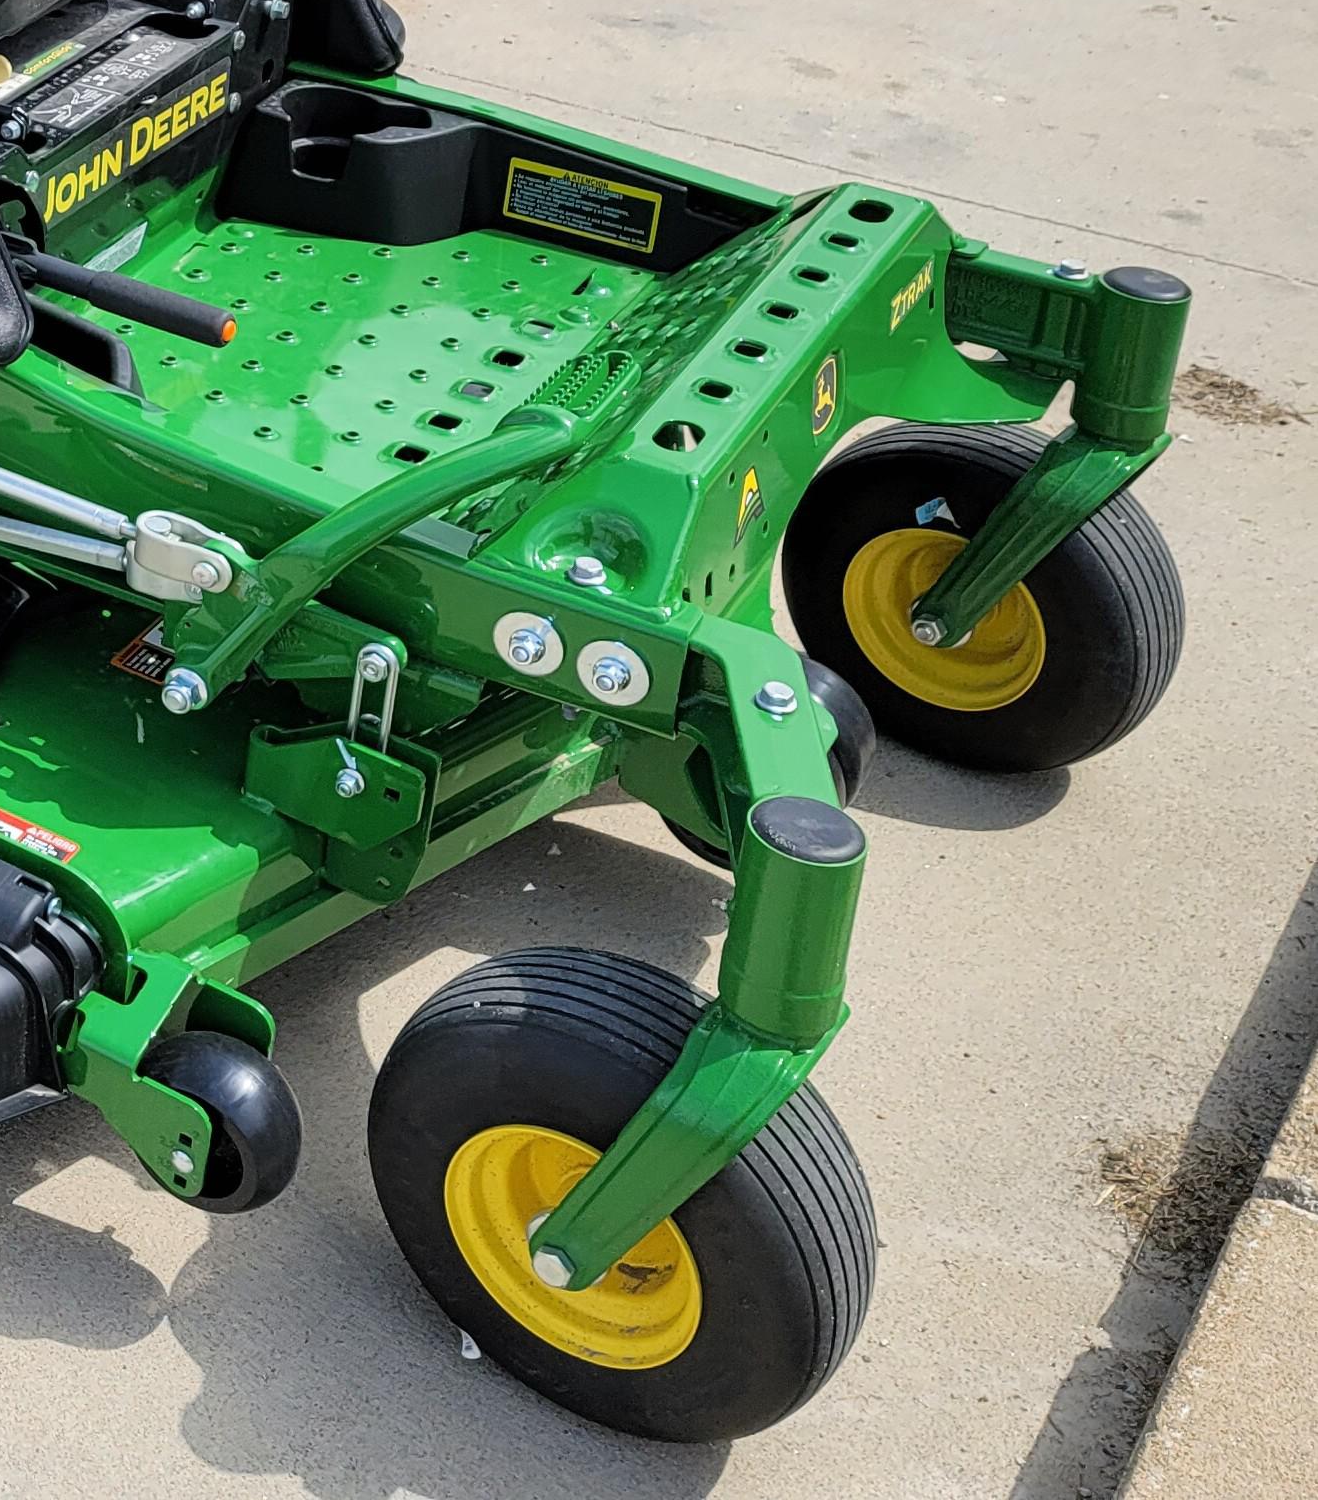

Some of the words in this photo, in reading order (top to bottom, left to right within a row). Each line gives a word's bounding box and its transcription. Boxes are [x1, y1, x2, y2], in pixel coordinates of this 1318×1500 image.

[43, 139, 123, 223] JOHN
[129, 72, 228, 166] DEERE
[890, 260, 932, 332] ZTRAK
[37, 828, 77, 853] PELIGRO
